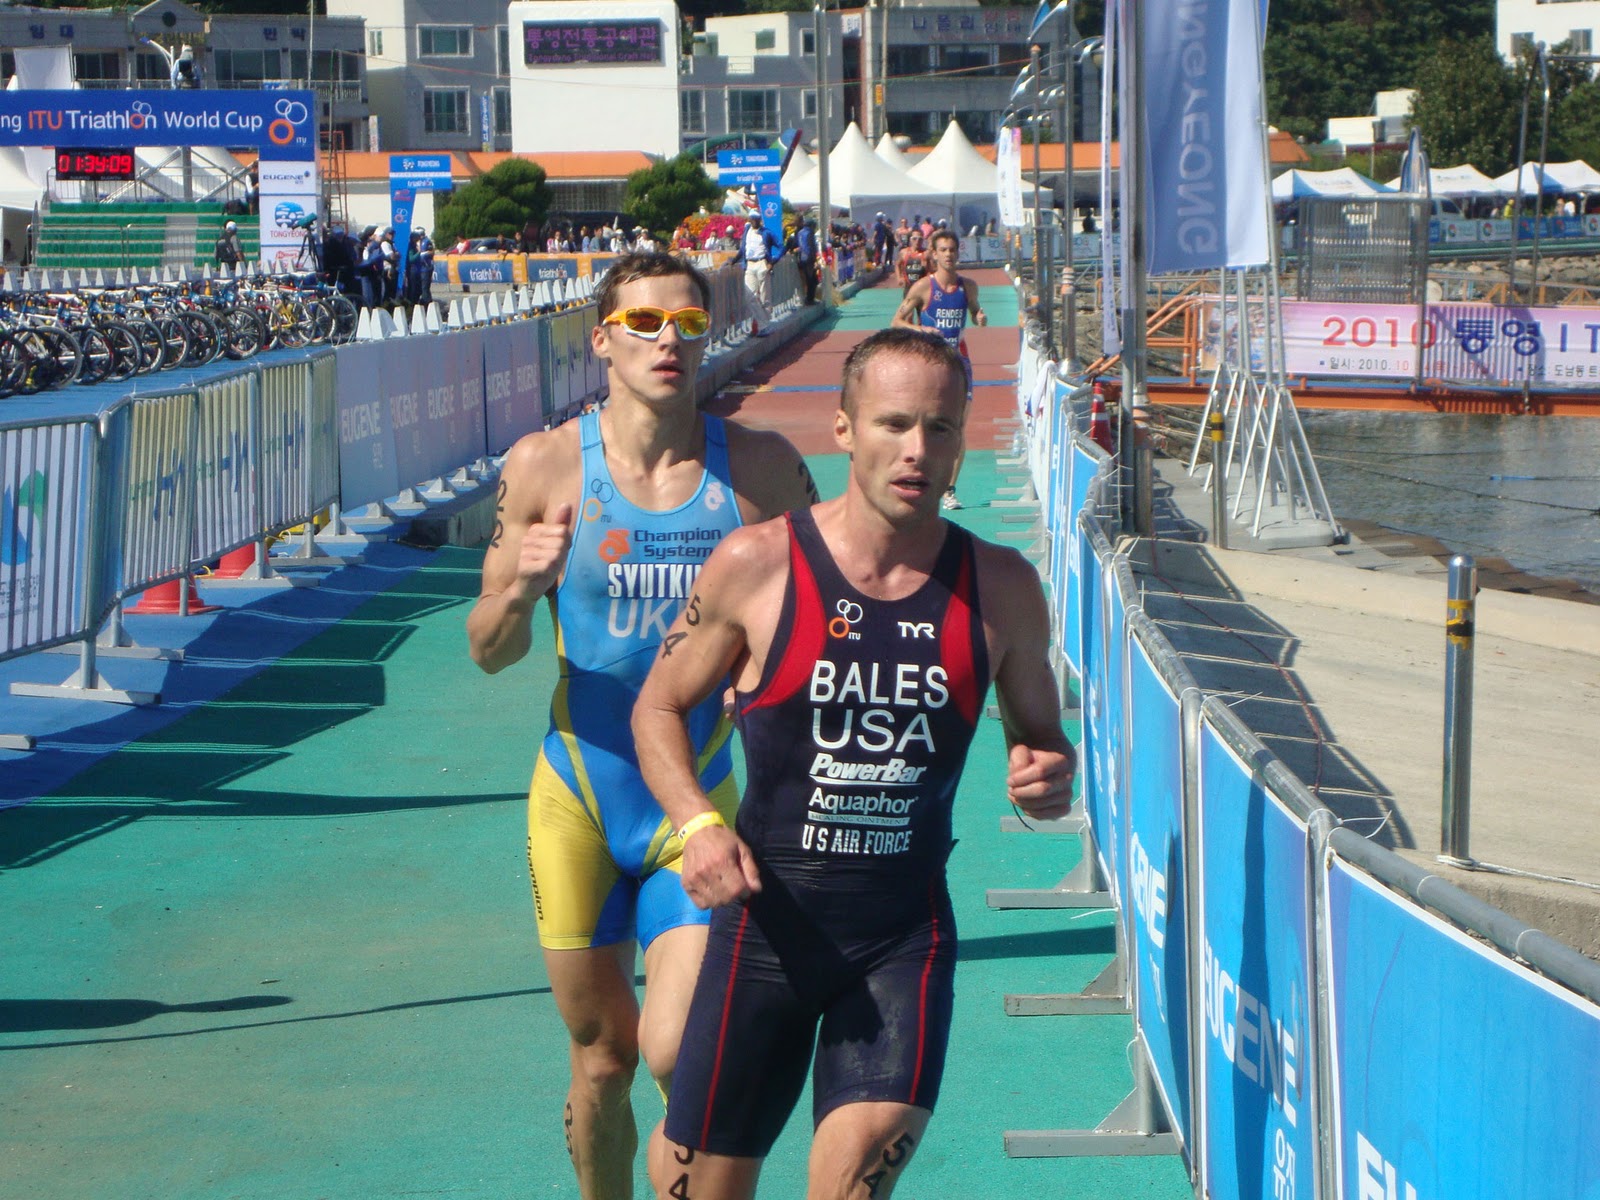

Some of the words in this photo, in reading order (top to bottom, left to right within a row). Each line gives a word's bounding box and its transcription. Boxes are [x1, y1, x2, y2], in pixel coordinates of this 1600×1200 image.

[527, 26, 658, 49] 통영전통공예관
[28, 110, 63, 130] ITU
[66, 102, 157, 130] Triathlon
[164, 110, 220, 129] World
[225, 110, 263, 133] Cup
[469, 263, 503, 281] triathlon
[538, 264, 567, 279] triathlon
[937, 318, 962, 328] HUN
[1322, 315, 1437, 350] 2010
[1454, 318, 1541, 357] 통영
[341, 400, 381, 444] EUGENE
[633, 527, 722, 545] Champion
[643, 545, 713, 560] System
[607, 599, 688, 641] UK
[897, 621, 936, 639] TYR
[848, 631, 862, 641] ITU
[809, 659, 950, 709] BALES
[812, 708, 936, 753] USA
[809, 752, 928, 784] PowerBar
[808, 786, 916, 815] Aquaphor
[830, 828, 861, 854] AIR
[863, 829, 913, 855] FORCE
